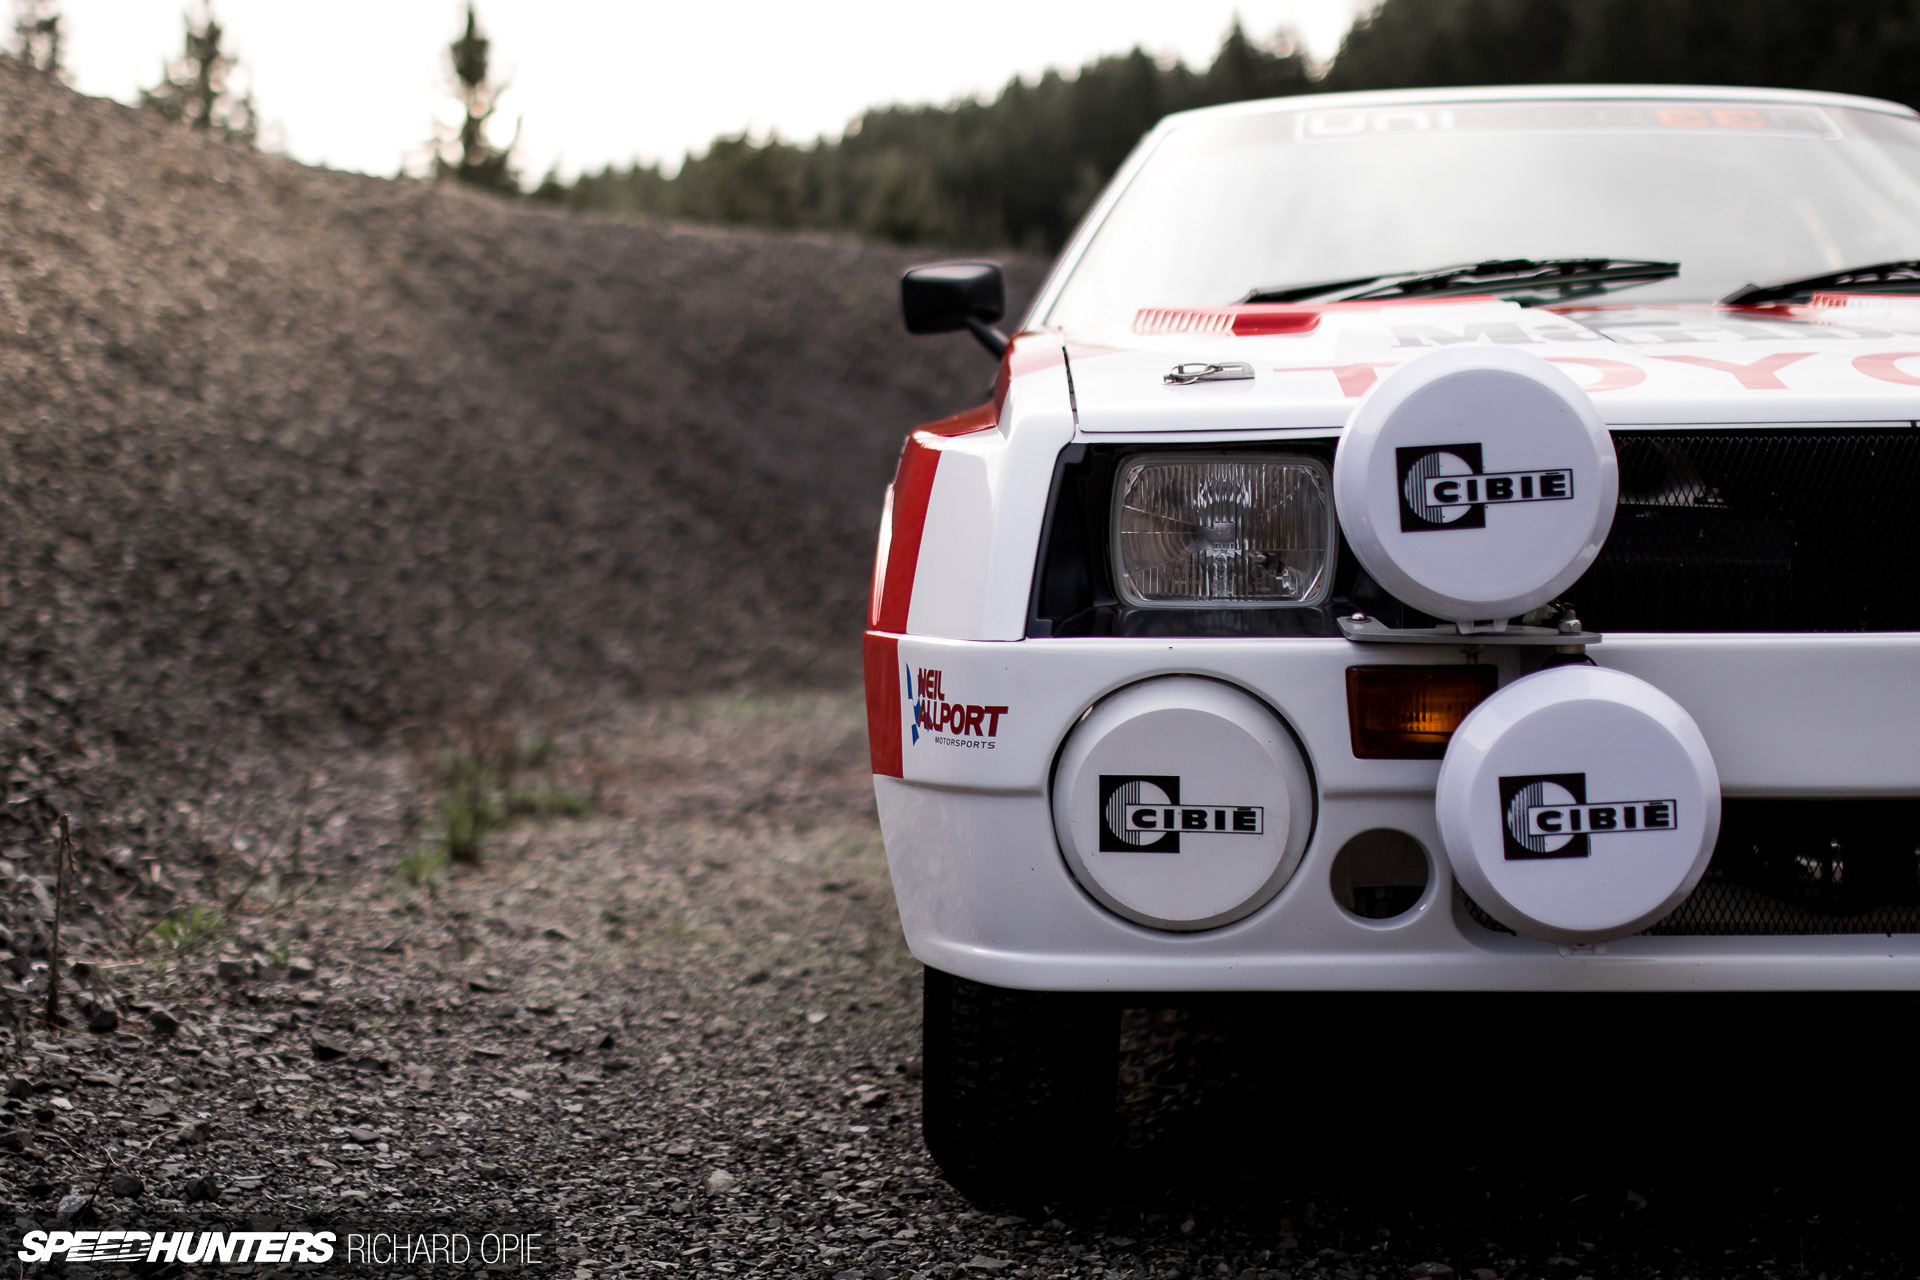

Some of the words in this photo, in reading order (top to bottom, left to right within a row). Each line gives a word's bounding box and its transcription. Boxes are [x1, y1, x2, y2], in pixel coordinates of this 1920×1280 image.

[917, 668, 945, 701] NEIL
[918, 698, 1009, 737] ALLPORT
[935, 736, 996, 749] MOTORSPORTS
